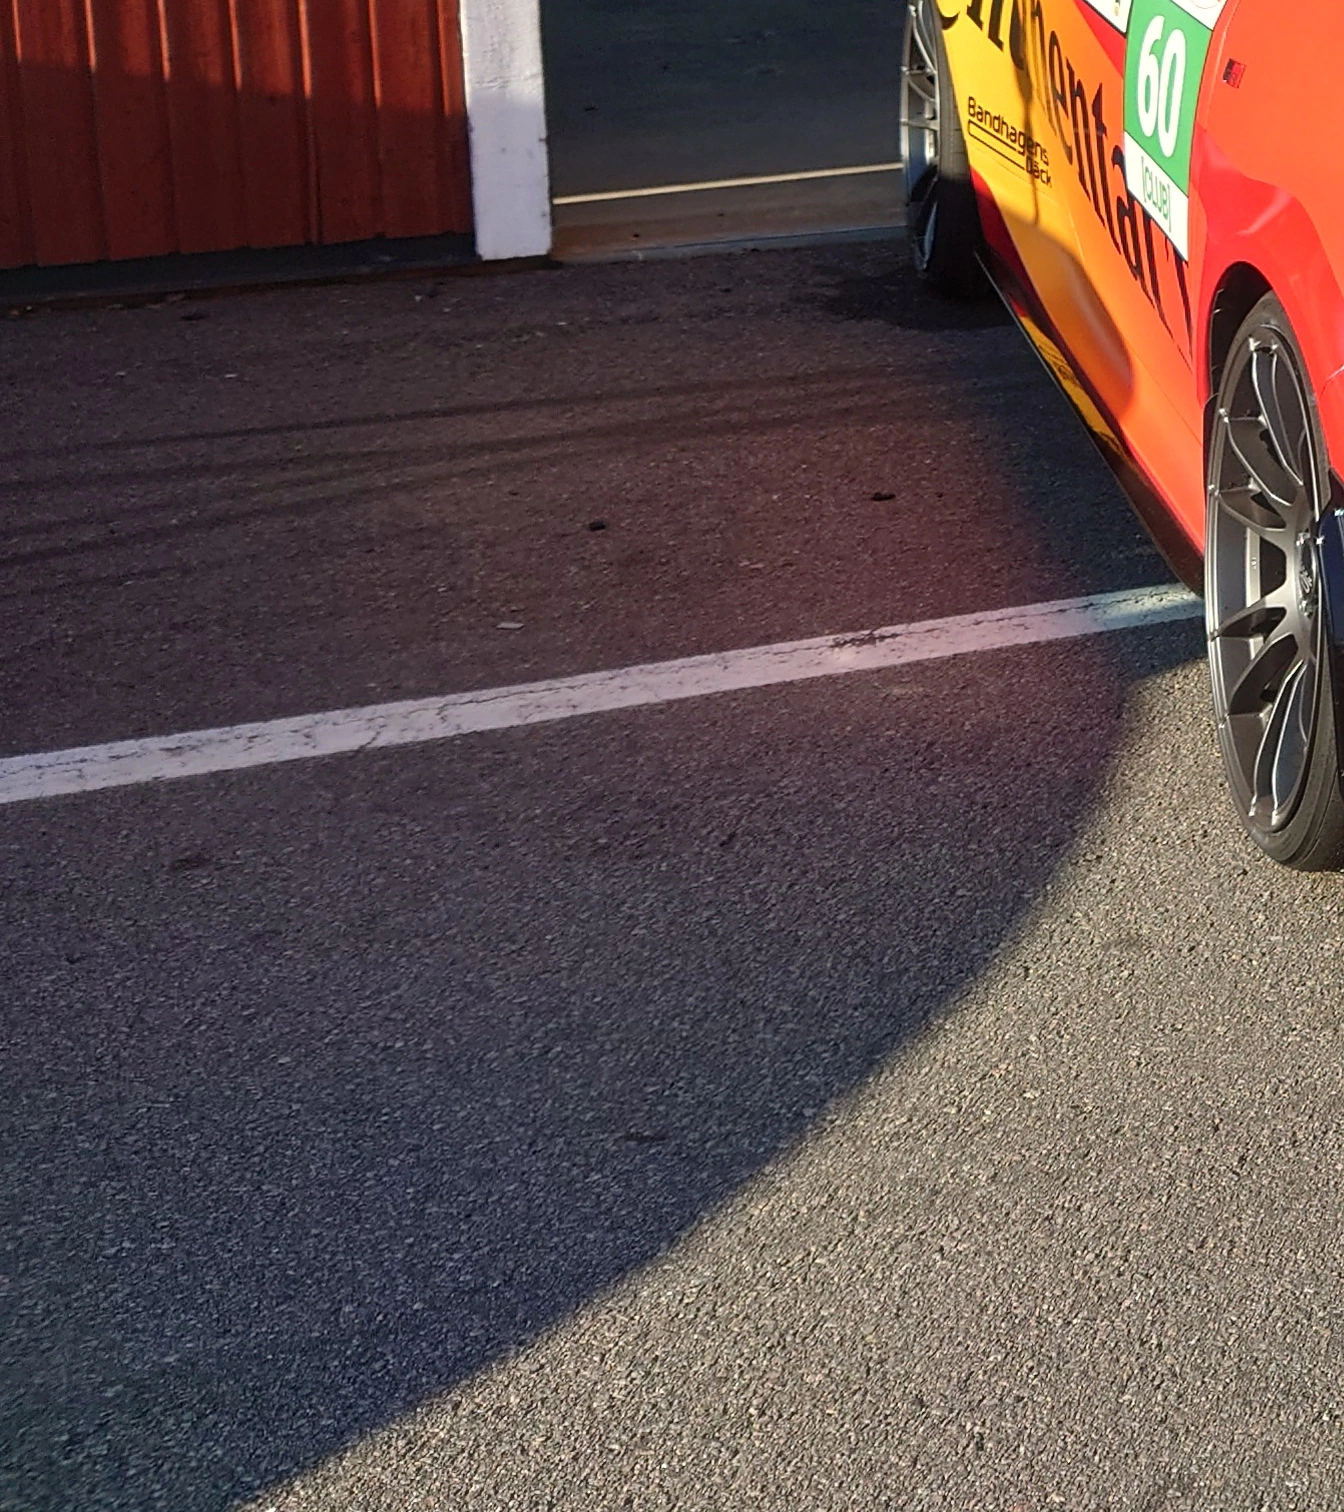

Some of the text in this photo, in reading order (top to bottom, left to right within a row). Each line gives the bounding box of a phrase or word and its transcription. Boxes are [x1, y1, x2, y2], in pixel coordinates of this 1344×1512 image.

[1136, 14, 1187, 159] 60
[968, 95, 1049, 167] Bandhagens
[1025, 154, 1053, 189] Däck
